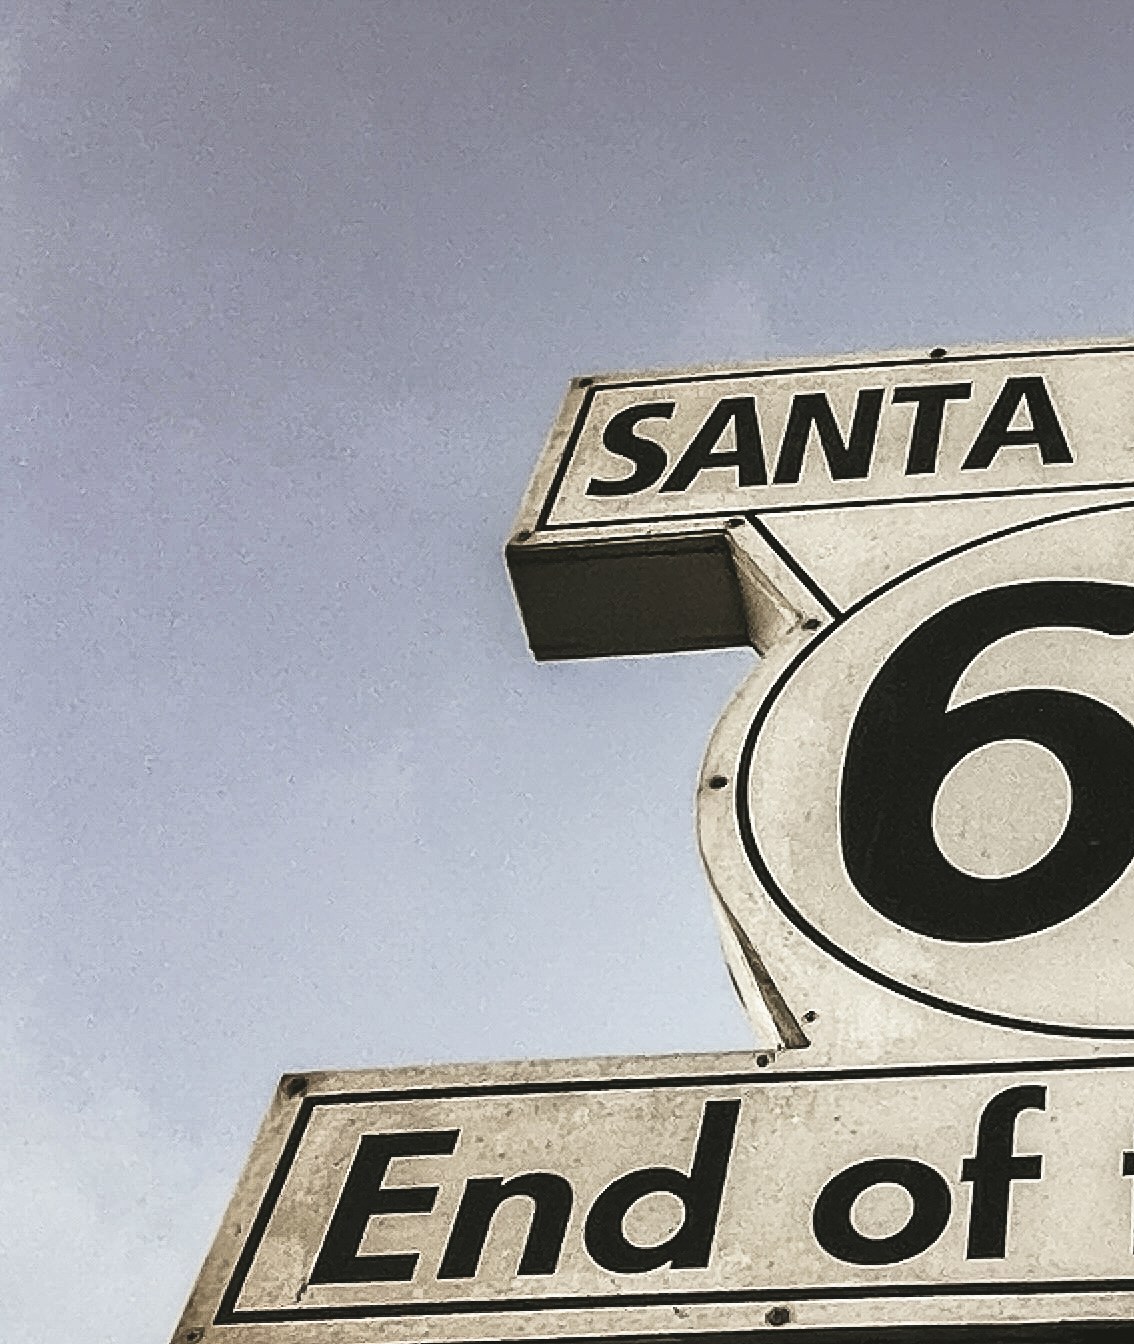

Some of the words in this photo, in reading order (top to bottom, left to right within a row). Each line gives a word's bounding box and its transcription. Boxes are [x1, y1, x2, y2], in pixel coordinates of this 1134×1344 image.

[584, 376, 1074, 497] SANTA
[307, 1098, 742, 1285] End
[812, 1084, 1048, 1266] of
